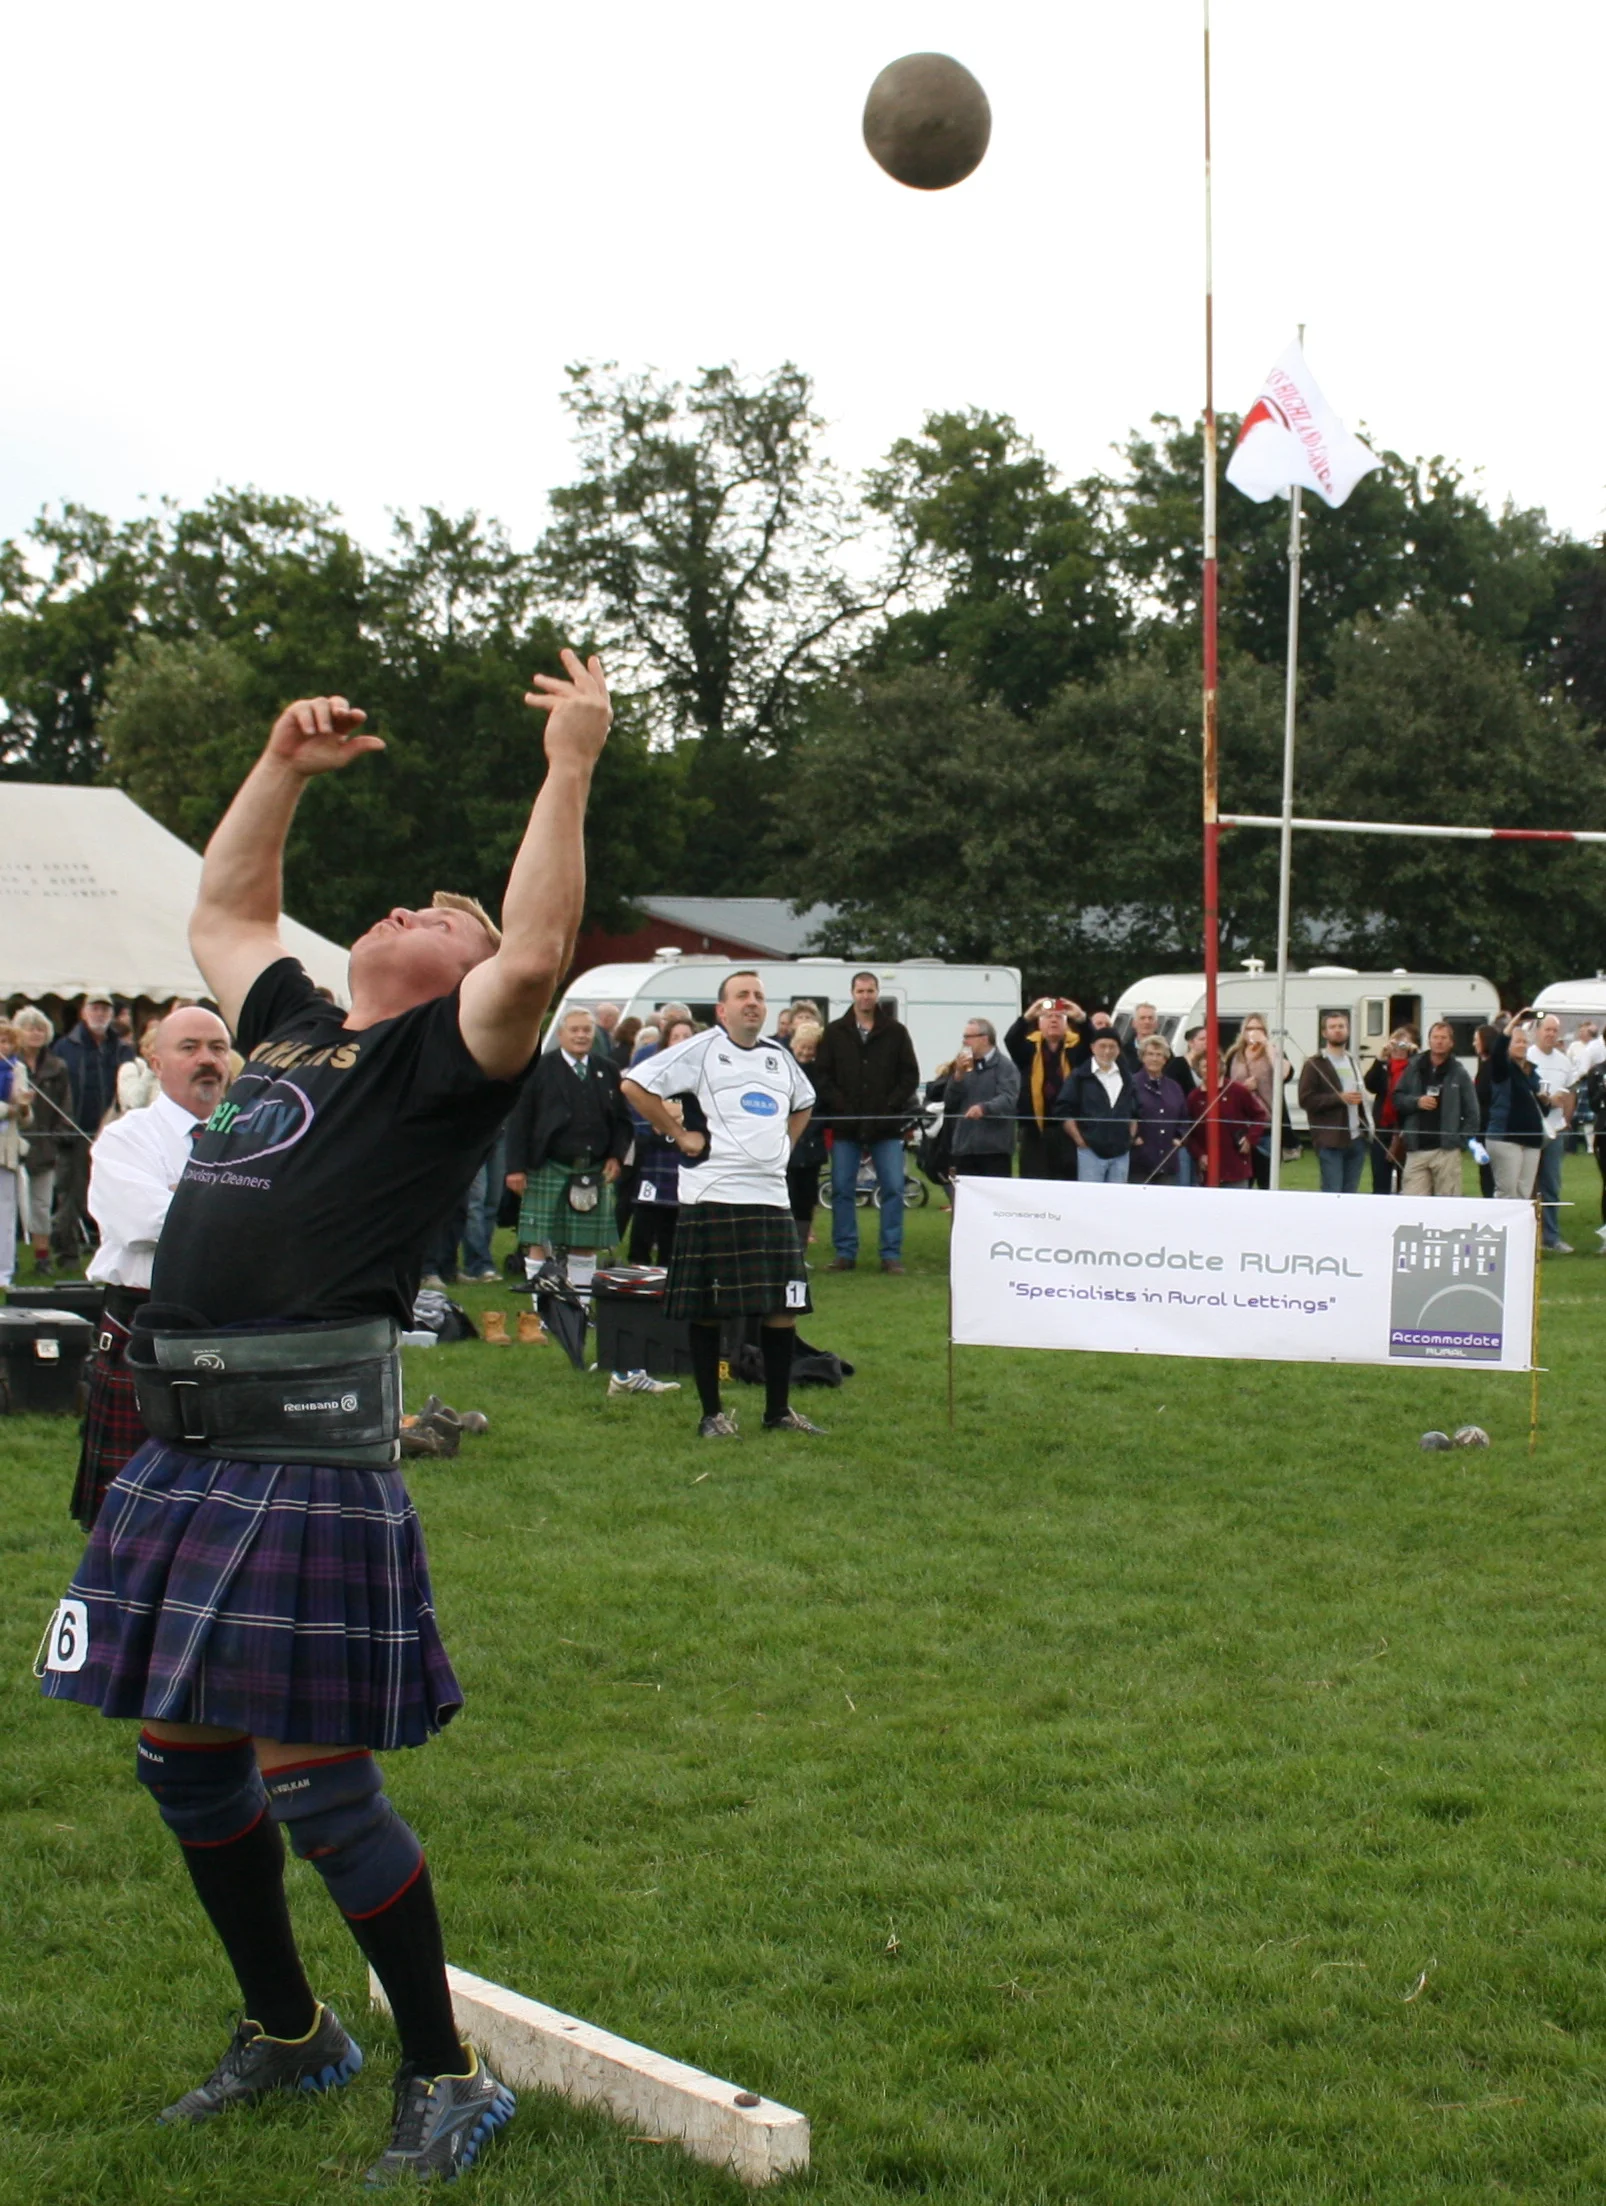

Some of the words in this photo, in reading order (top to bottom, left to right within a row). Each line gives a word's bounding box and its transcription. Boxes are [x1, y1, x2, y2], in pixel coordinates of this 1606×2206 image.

[220, 1171, 272, 1190] Cleaners
[993, 1210, 1046, 1220] sponsored
[1048, 1211, 1061, 1221] by
[990, 1240, 1224, 1271] Accommodate
[1240, 1252, 1363, 1278] RURAL
[789, 1284, 798, 1303] 1
[1009, 1281, 1137, 1302] "Specialists
[1142, 1288, 1162, 1303] in
[1168, 1290, 1228, 1306] Rural
[1233, 1292, 1337, 1314] Lettings"
[1391, 1331, 1500, 1347] Accommodate
[1425, 1347, 1467, 1357] RURAL
[57, 1611, 76, 1662] 6
